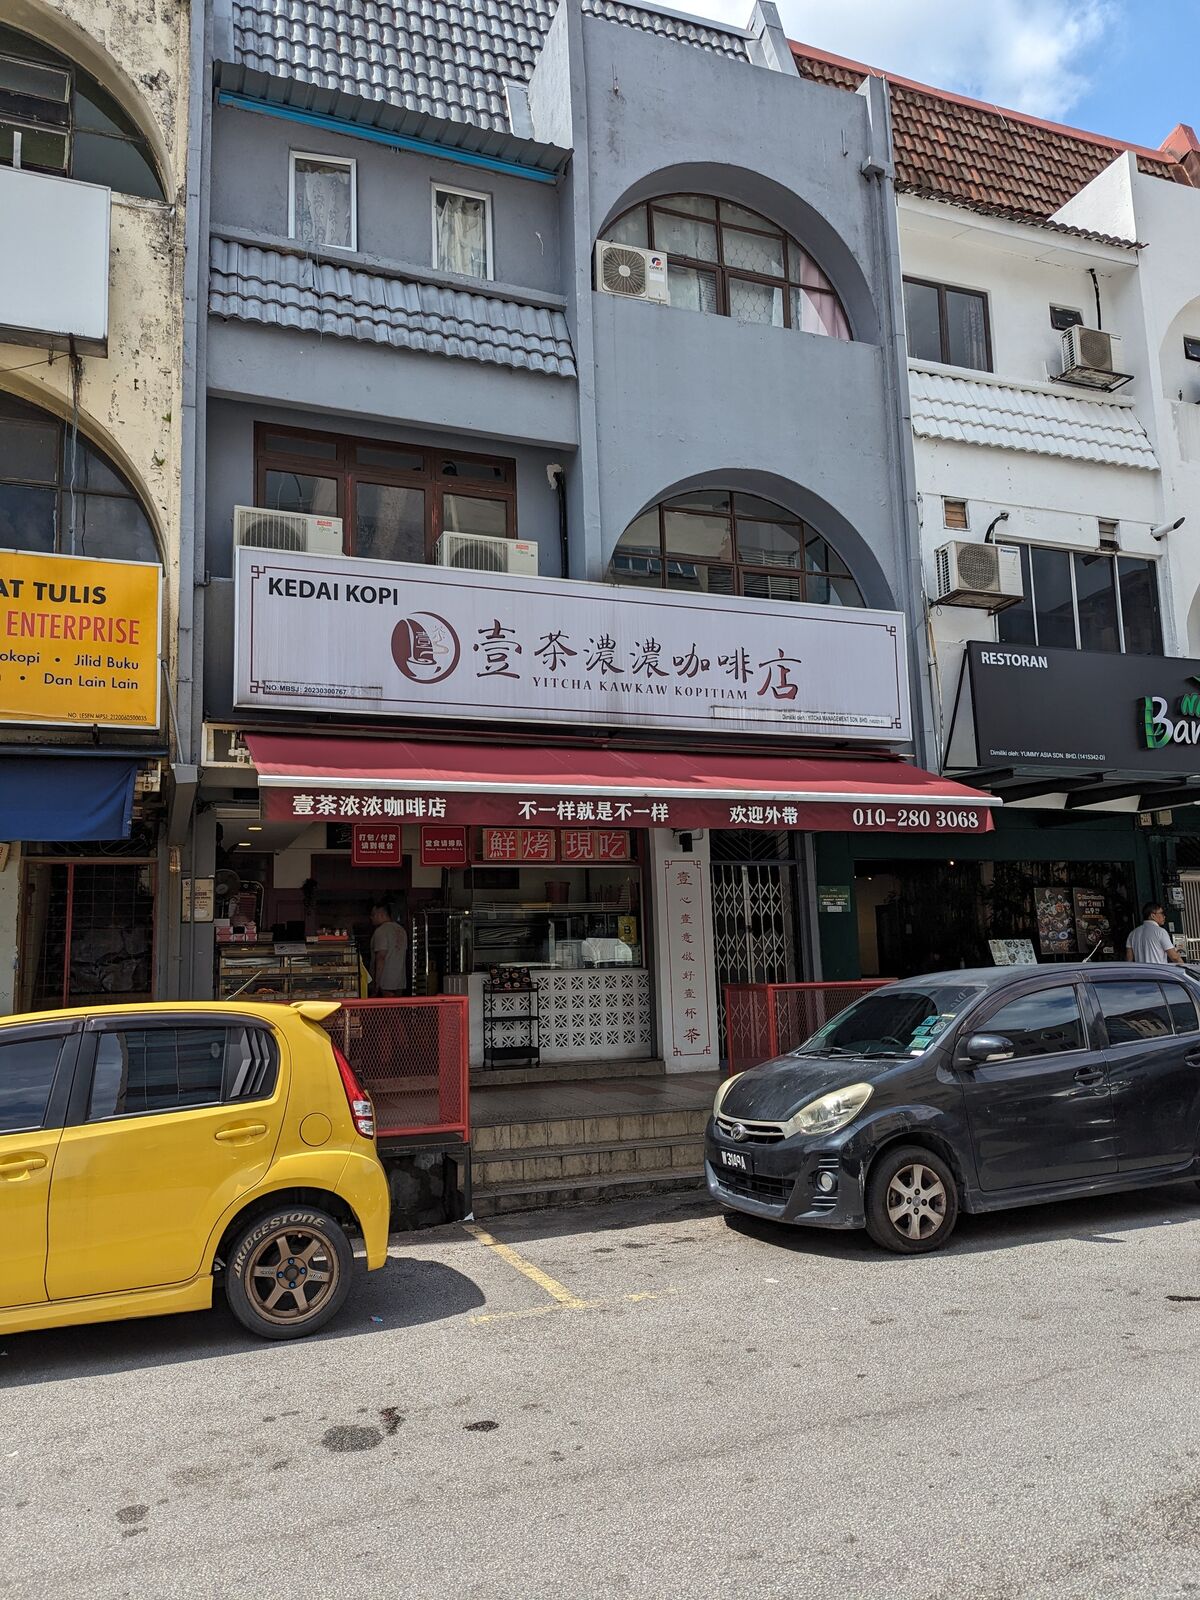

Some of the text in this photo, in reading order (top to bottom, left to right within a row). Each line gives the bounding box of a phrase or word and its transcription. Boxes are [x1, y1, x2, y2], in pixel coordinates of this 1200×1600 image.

[33, 582, 107, 604] TULIS
[268, 577, 399, 606] KEDAI KOPI
[6, 610, 140, 645] ENTERPRISE
[74, 655, 101, 667] Jilid
[107, 657, 139, 670] Buku
[473, 619, 802, 700] 壹茶濃濃咖啡店
[981, 651, 1048, 669] RESTORAN
[44, 673, 139, 690] Dan Lain Lain
[532, 676, 748, 700] YITCHA KAWKAW KOPITIAM
[292, 795, 447, 818] 壹茶浓浓咖啡店
[518, 800, 669, 823] 不一样就是不一样
[729, 806, 799, 825] 欢迎外带
[852, 808, 979, 828] 010-280 3068
